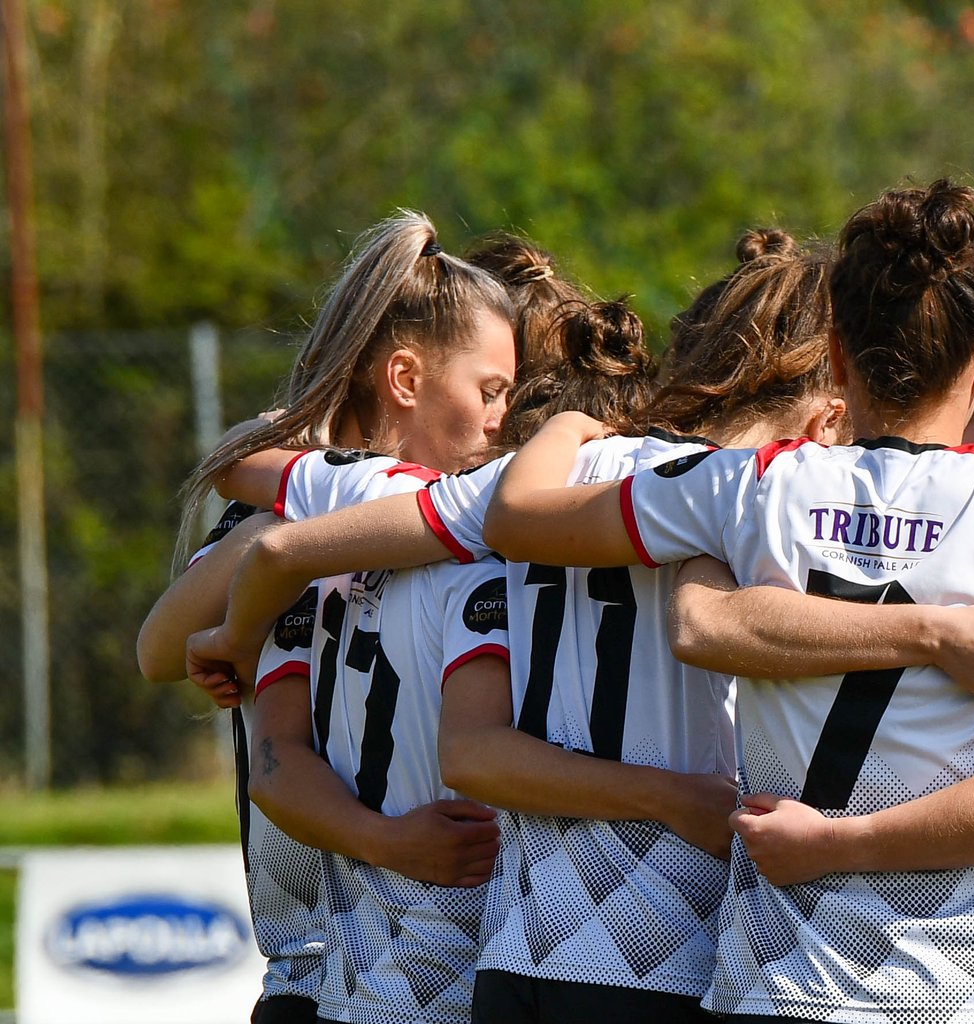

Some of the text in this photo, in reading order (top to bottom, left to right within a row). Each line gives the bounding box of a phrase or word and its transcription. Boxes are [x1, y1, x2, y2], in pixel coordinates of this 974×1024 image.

[809, 508, 944, 552] TRIBUTE
[821, 550, 871, 569] CORNISH
[873, 559, 897, 571] PALE
[313, 587, 400, 814] 17
[517, 562, 637, 762] 11
[800, 569, 916, 810] 7
